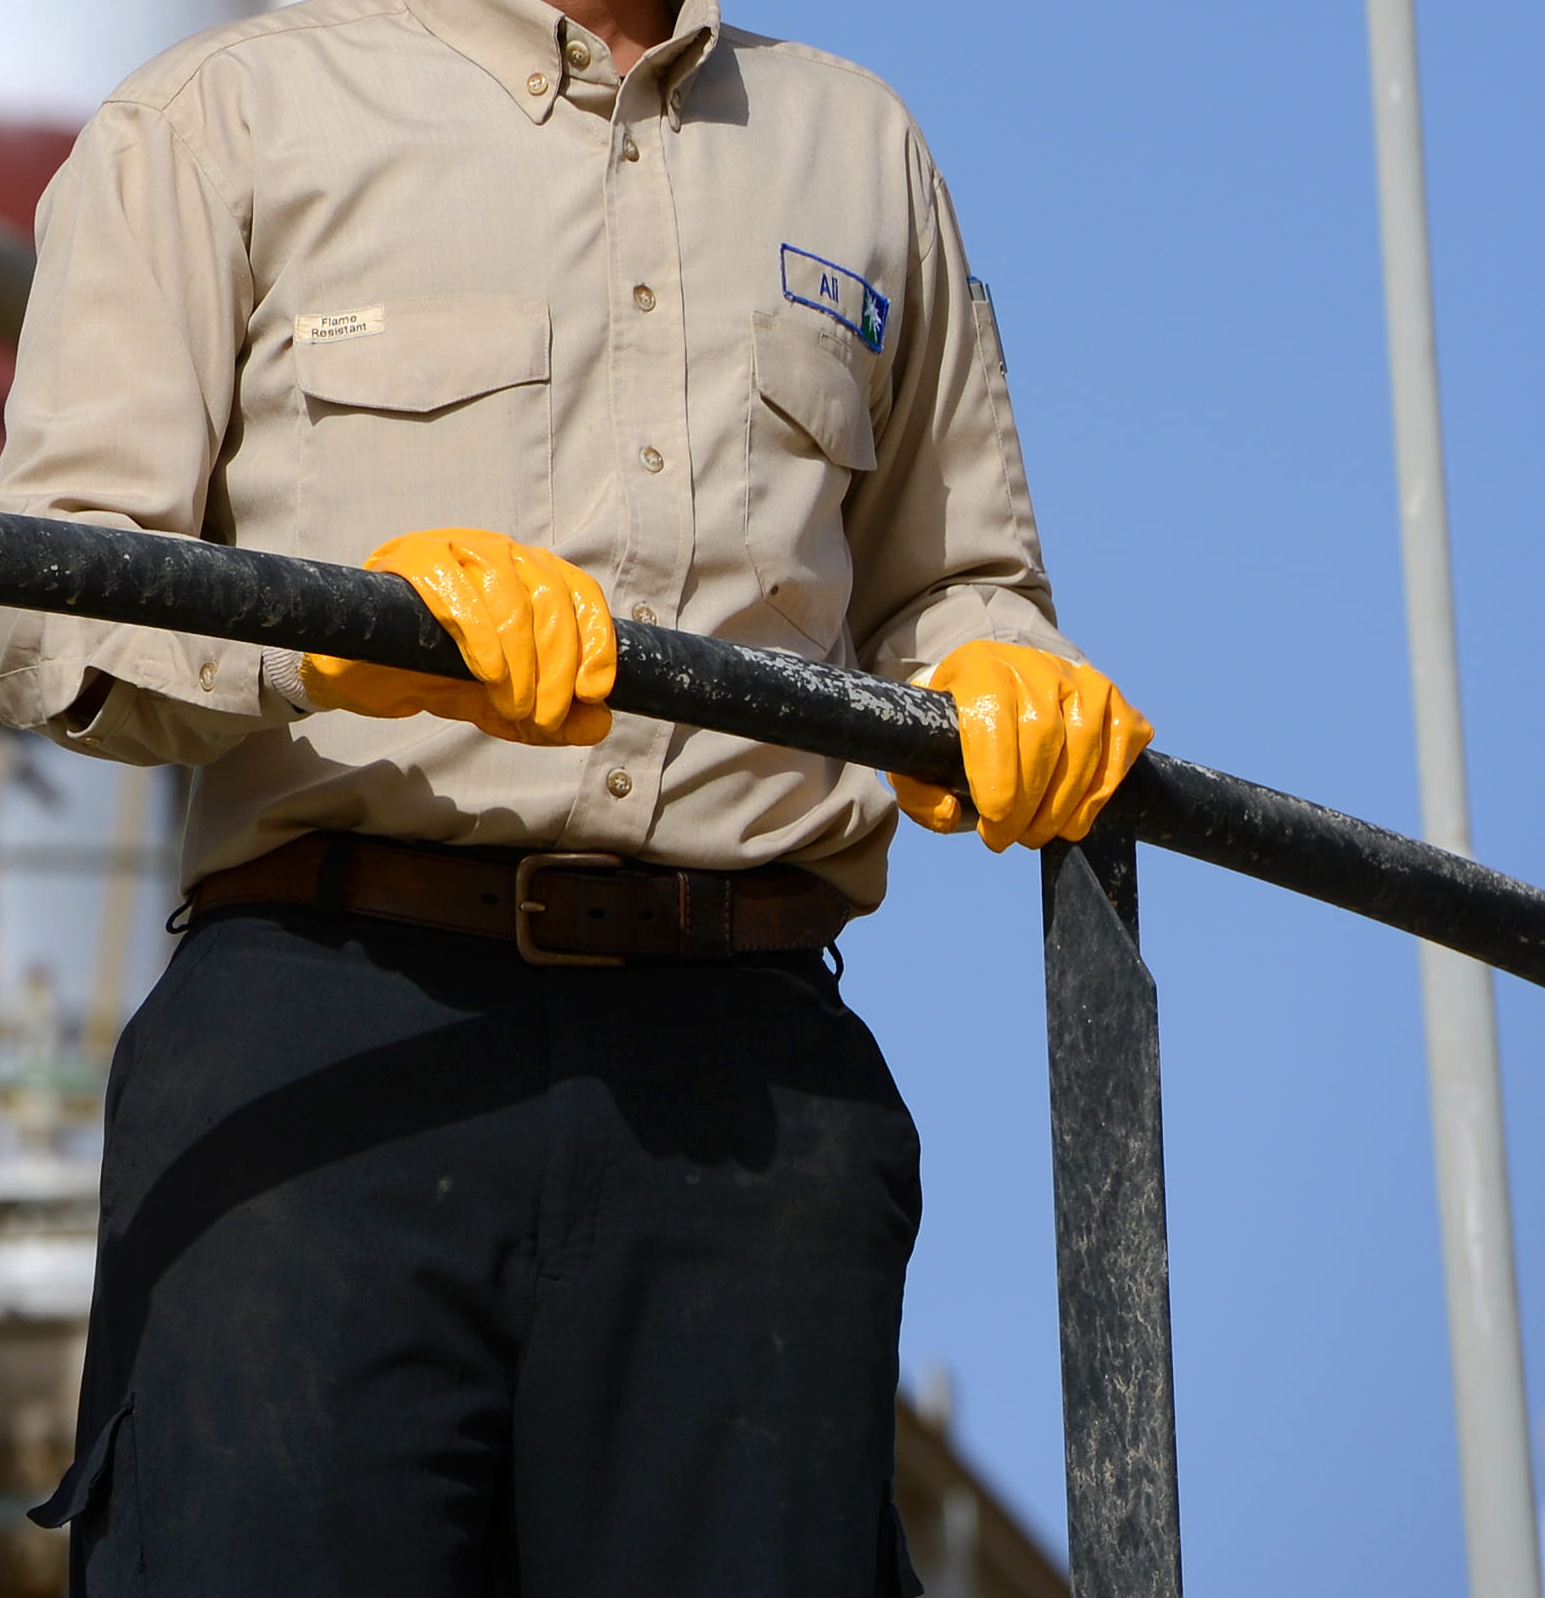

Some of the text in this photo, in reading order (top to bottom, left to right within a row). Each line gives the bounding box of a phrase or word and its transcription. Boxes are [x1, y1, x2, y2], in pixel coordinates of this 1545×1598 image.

[820, 273, 839, 304] Ali
[321, 314, 357, 327] Flame
[311, 322, 367, 338] Resistant
